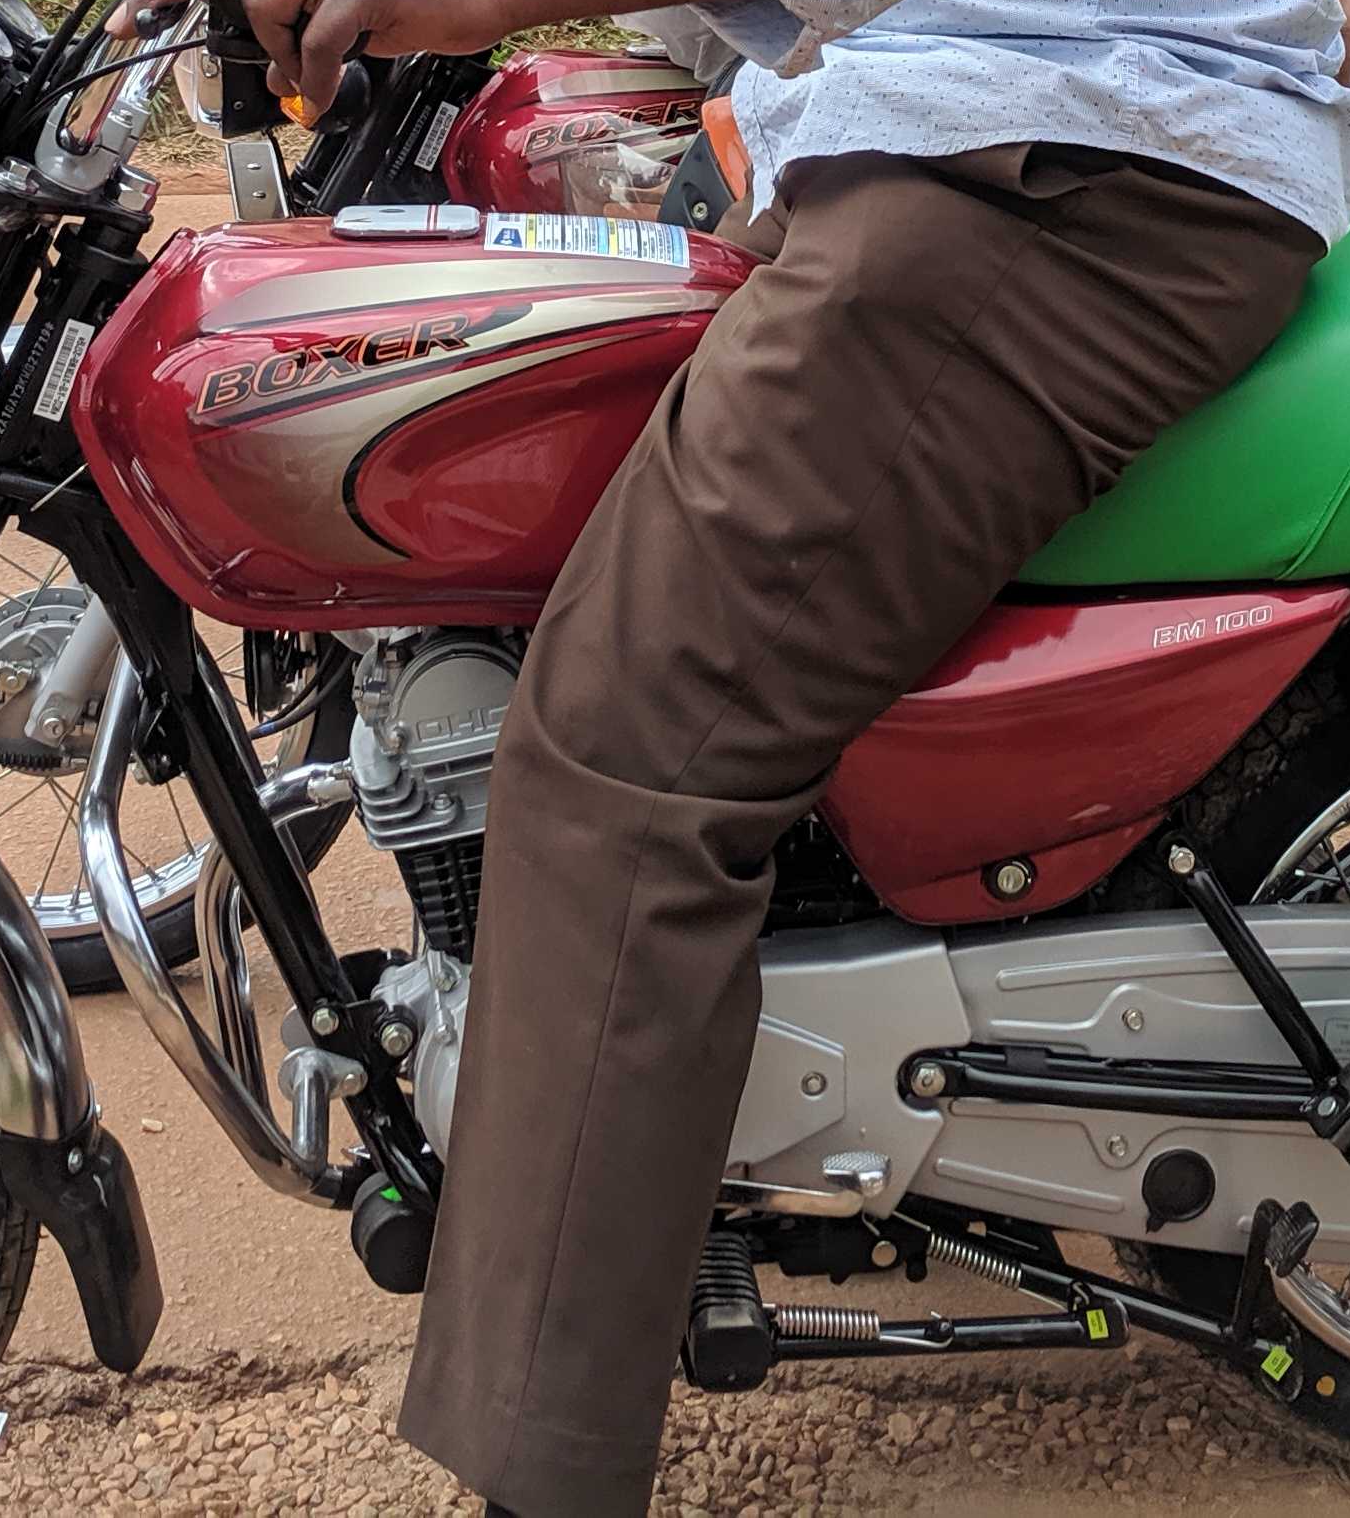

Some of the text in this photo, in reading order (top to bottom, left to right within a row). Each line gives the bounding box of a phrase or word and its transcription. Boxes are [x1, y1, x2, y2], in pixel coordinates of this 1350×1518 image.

[521, 97, 703, 157] BOXER
[196, 314, 471, 414] BOXER
[1153, 604, 1274, 649] BM 100
